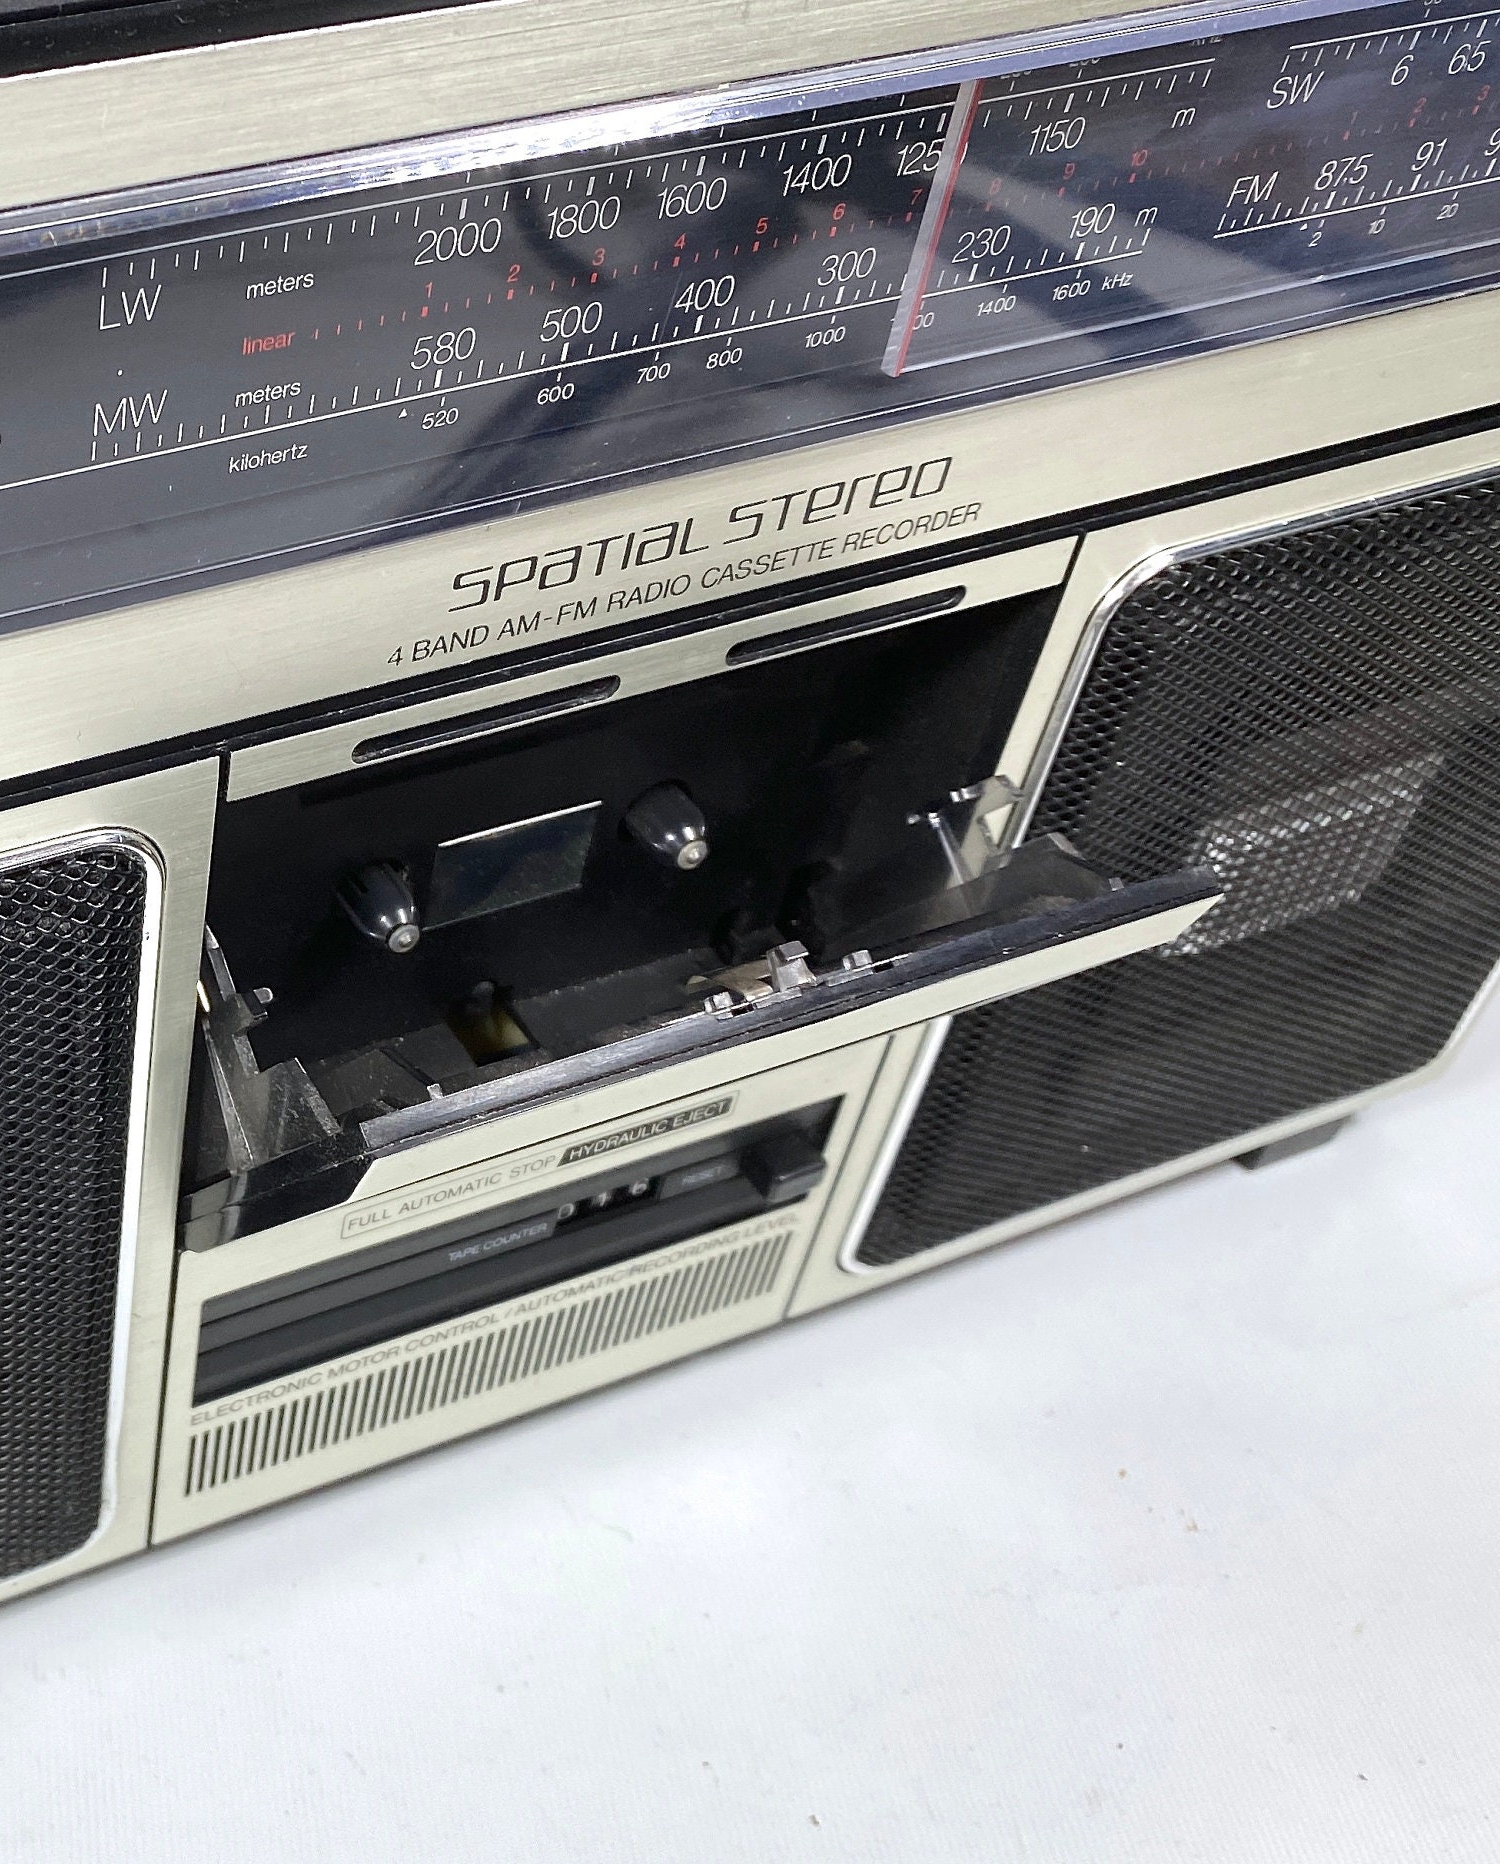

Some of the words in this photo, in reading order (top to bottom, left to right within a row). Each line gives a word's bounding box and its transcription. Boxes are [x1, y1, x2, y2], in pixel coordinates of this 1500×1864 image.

[1267, 71, 1324, 109] SW
[1390, 54, 1414, 85] 6
[99, 285, 161, 330] LW
[245, 271, 314, 300] meters
[414, 217, 502, 266] 2000
[547, 195, 621, 240] 1800
[657, 177, 727, 220] 1600
[783, 154, 852, 197] 1400
[1029, 117, 1086, 155] 1150
[1171, 107, 1197, 128] m
[1227, 171, 1279, 208] FM
[1411, 138, 1448, 171] 91
[1308, 231, 1322, 247] 2
[1368, 218, 1386, 235] 10
[1436, 203, 1460, 220] 20
[242, 329, 296, 357] linear
[426, 281, 434, 298] 1
[508, 263, 522, 283] 2
[592, 248, 605, 266] 3
[674, 232, 687, 250] 4
[755, 217, 768, 235] 5
[833, 203, 846, 221] 6
[912, 189, 923, 205] 7
[1063, 162, 1076, 179] 9
[1132, 149, 1148, 167] 10
[93, 389, 167, 437] MW
[235, 379, 301, 408] meters
[411, 326, 477, 370] 580
[540, 301, 603, 343] 500
[675, 275, 736, 314] 400
[817, 247, 877, 287] 300
[951, 225, 1012, 264] 230
[1070, 203, 1115, 239] 190
[1134, 206, 1158, 227] m
[228, 441, 308, 474] kilohertz
[422, 406, 459, 430] 520
[537, 382, 575, 405] 600
[636, 361, 671, 385] 700
[706, 347, 743, 369] 800
[805, 326, 846, 350] 1000
[977, 295, 1016, 317] 1400
[1053, 280, 1091, 301] 1600
[1101, 272, 1134, 291] kHz
[387, 648, 404, 667] 4
[411, 623, 490, 664] BAND
[606, 573, 692, 612] RADIO
[701, 538, 836, 591] CASSETTE
[841, 502, 982, 553] RECORDER
[569, 1121, 669, 1161] HYDRAULIC
[672, 1101, 728, 1129] EJECT
[347, 1207, 391, 1231] FULL
[398, 1172, 502, 1214] AUTOMATIC
[509, 1155, 556, 1180] STOP
[449, 1243, 480, 1261] TAPE
[482, 1222, 548, 1251] COUNTER
[190, 1371, 322, 1426] ELECTRONIC
[326, 1345, 400, 1380] MOTOR
[404, 1313, 500, 1352] CONTROL
[514, 1271, 627, 1318] AUTOMATIC
[627, 1231, 740, 1276] RECORDING
